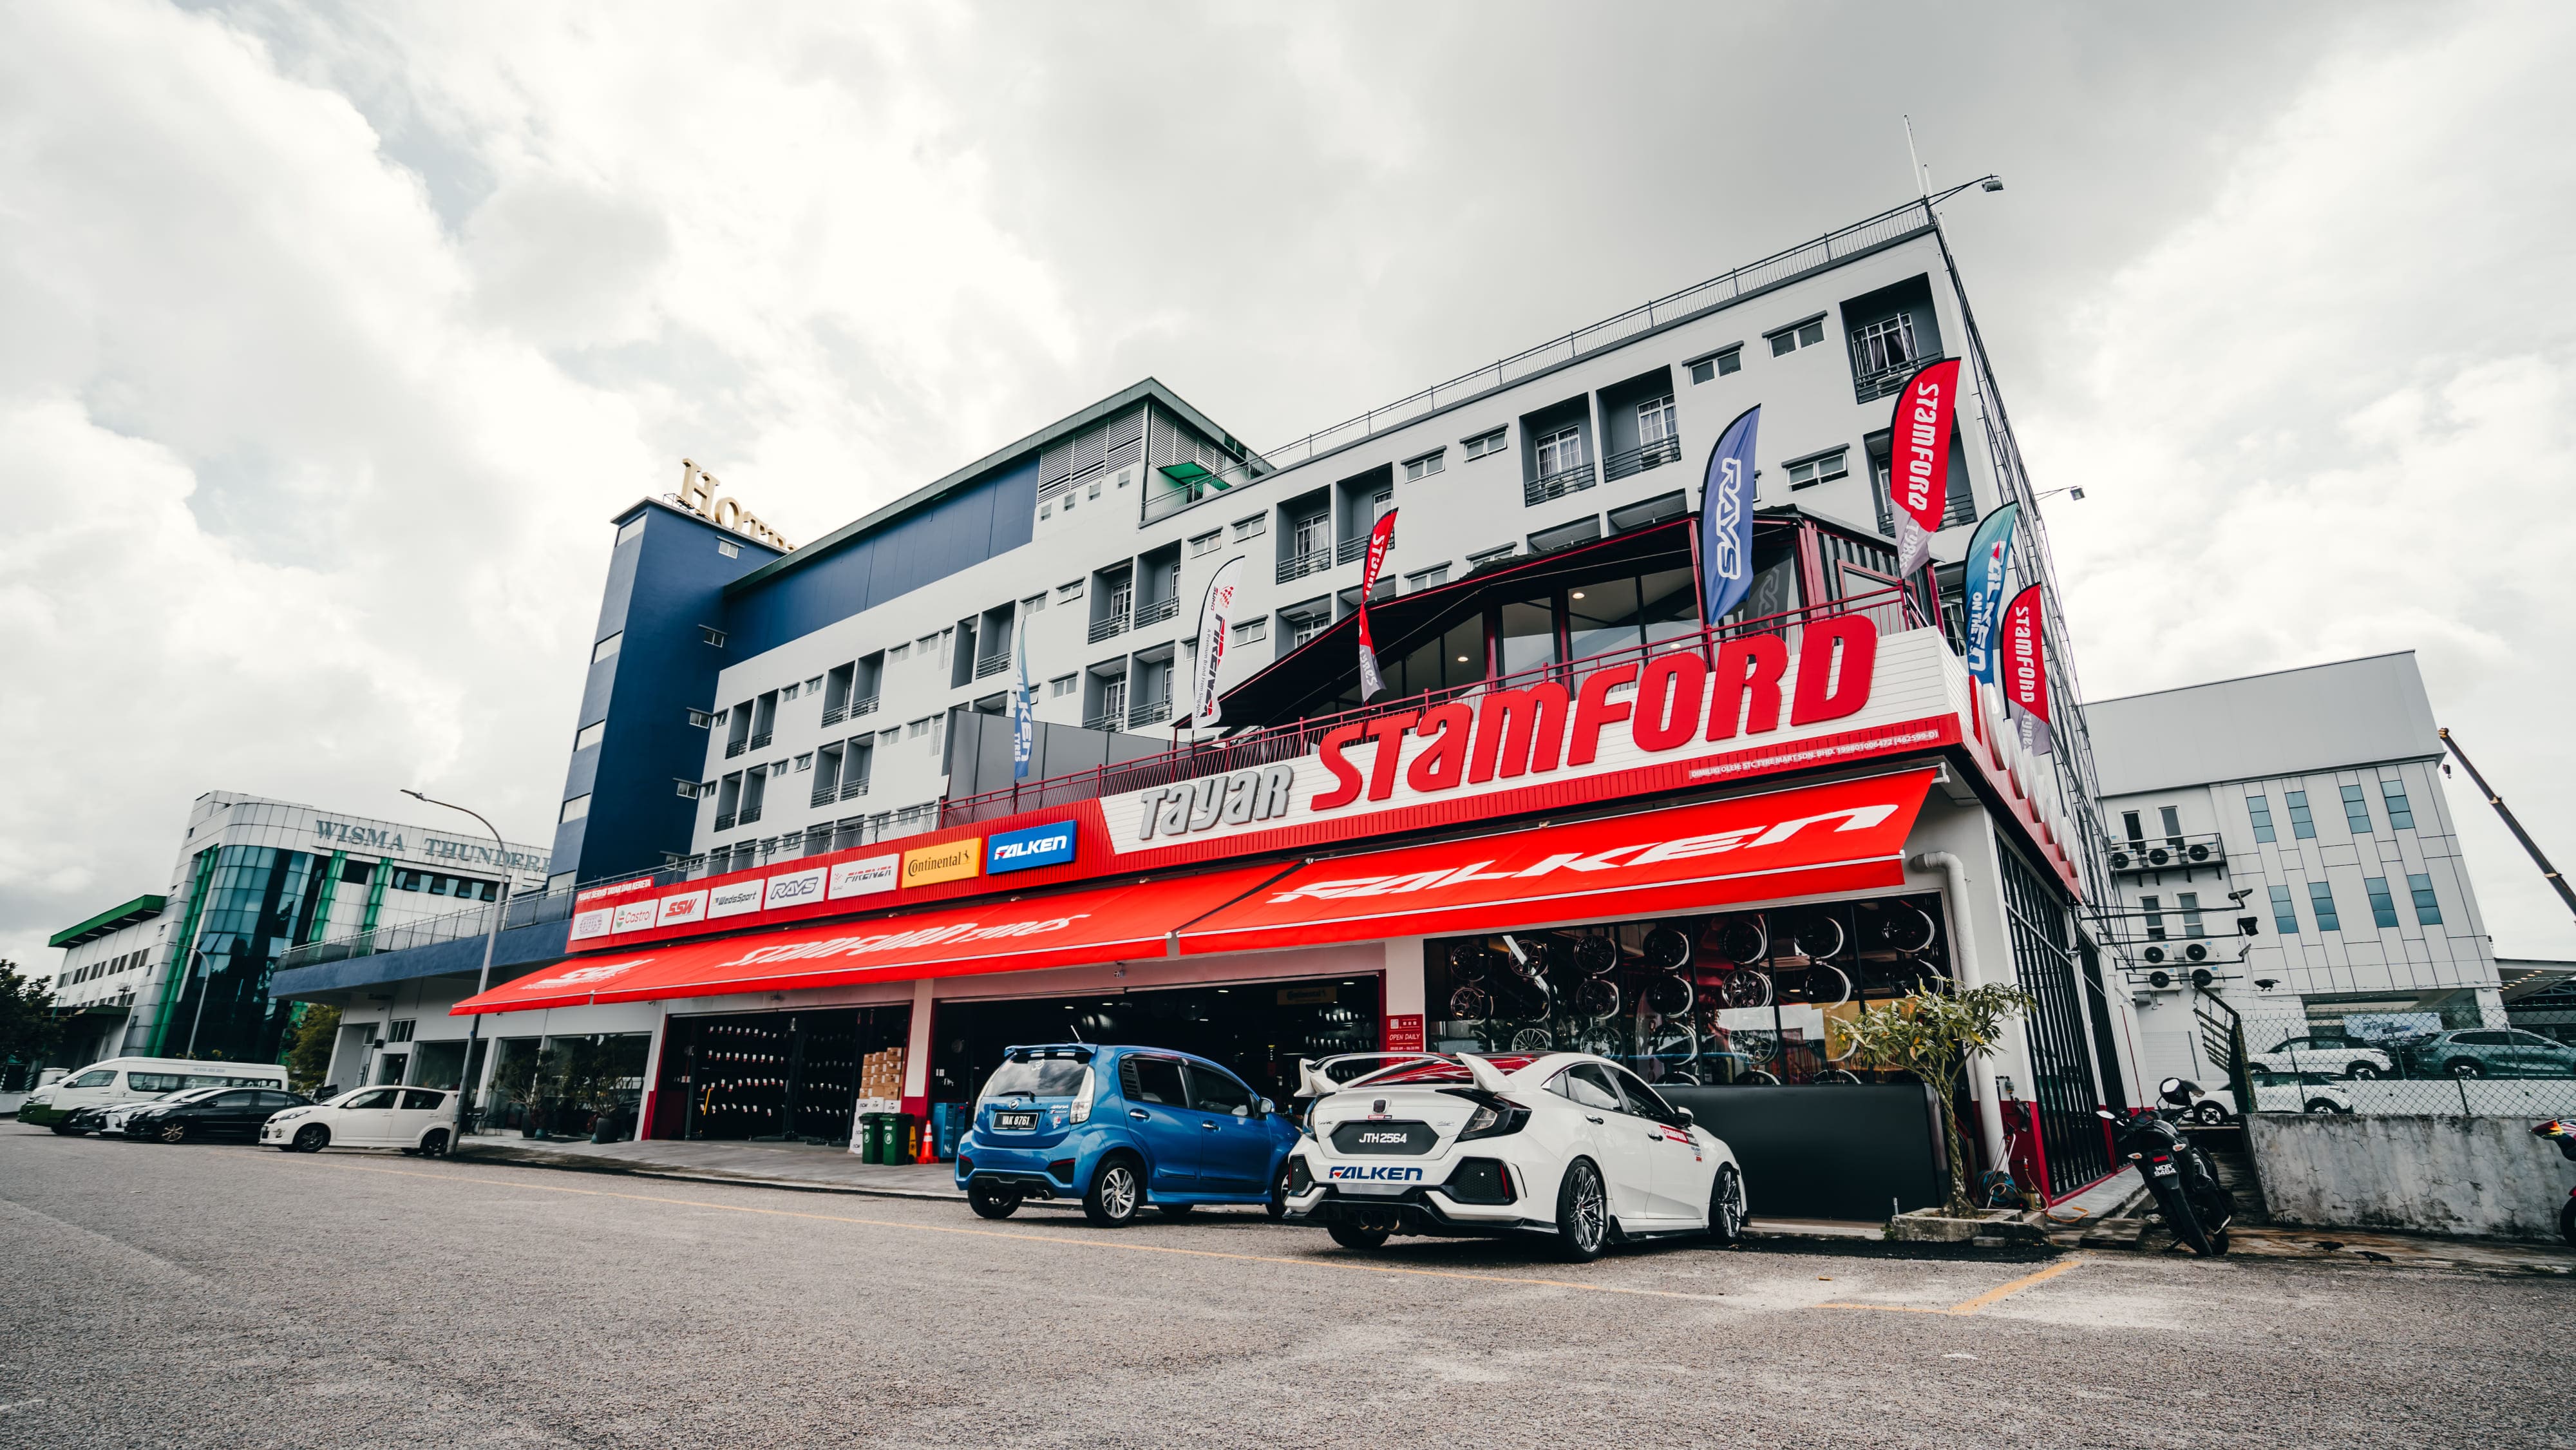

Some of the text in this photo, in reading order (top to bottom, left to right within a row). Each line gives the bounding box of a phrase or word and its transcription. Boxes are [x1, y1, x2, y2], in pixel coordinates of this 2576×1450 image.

[681, 458, 798, 551] HOTE
[1716, 458, 1741, 580] RAYS
[1972, 591, 1983, 611] ON
[1691, 767, 1720, 778] DIMILIKI
[1721, 763, 1742, 773] OLEH:
[1743, 761, 1757, 771] STC
[1757, 758, 1775, 768] TYRE
[1776, 754, 1797, 765] MART
[1817, 748, 1835, 758] BHD.
[316, 819, 405, 852] WISMA
[994, 835, 1067, 861] FALKEN
[908, 852, 961, 877] Continental
[718, 890, 758, 906] WedsSport
[770, 877, 819, 900] RAYS
[625, 909, 653, 924] Castrol
[664, 898, 697, 918] SSW
[1014, 1115, 1030, 1125] 8761
[1359, 1132, 1408, 1143] JTH 2564
[1329, 1166, 1423, 1181] FALKEN
